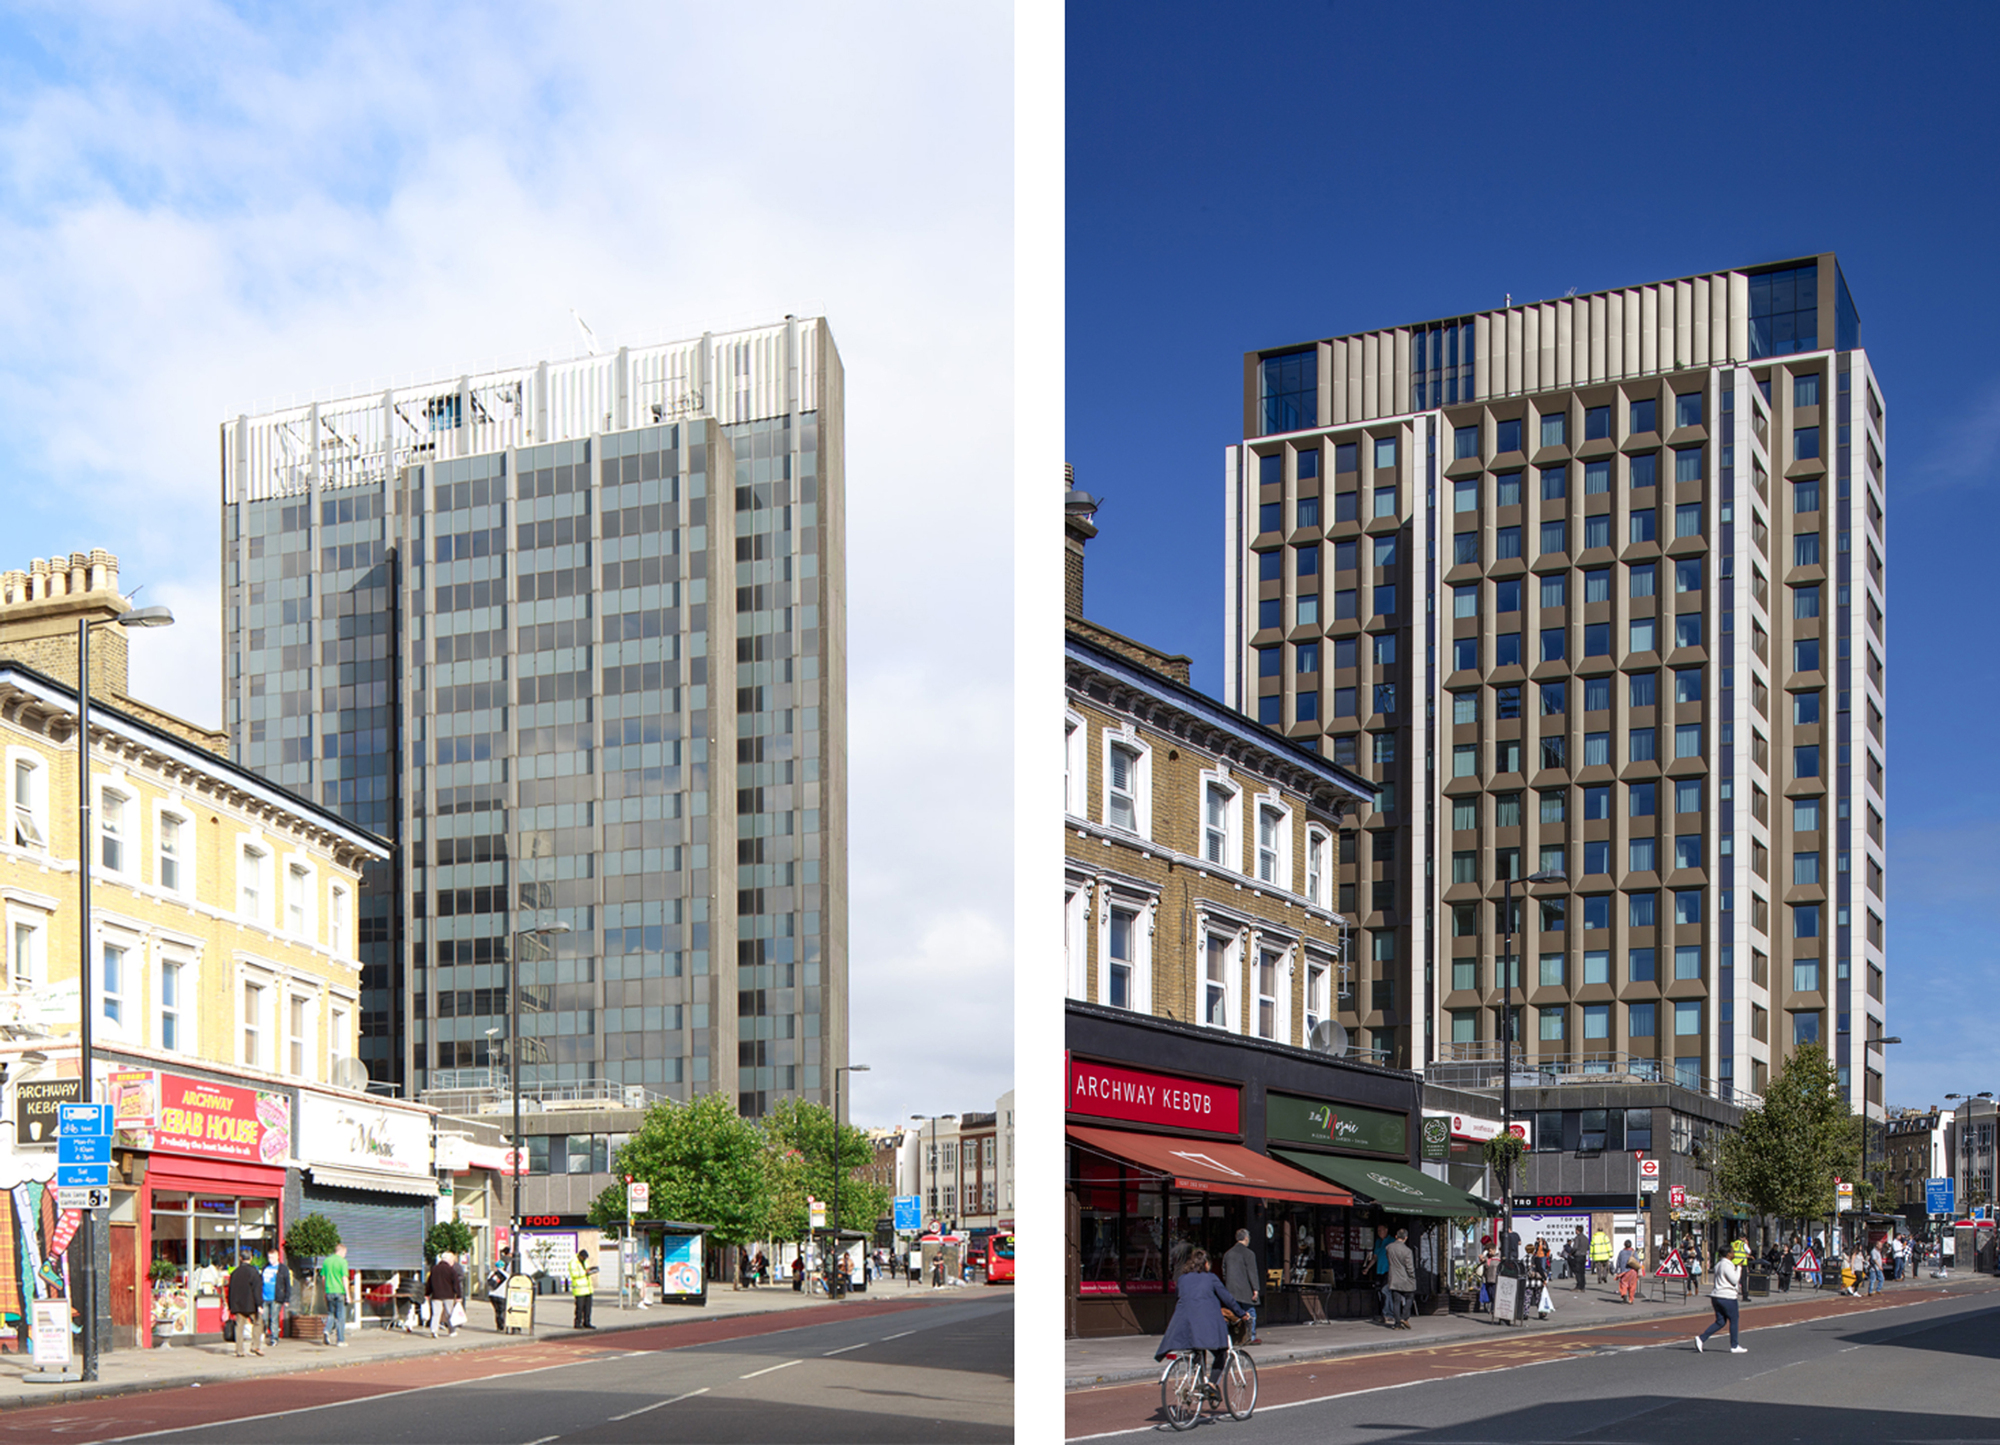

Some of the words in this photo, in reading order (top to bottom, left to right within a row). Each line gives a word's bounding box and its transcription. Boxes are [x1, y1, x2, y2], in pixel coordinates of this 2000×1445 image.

[17, 1083, 78, 1099] ARCHWAY
[1076, 1075, 1155, 1106] ARCHWAY
[26, 1100, 67, 1115] KEBA
[181, 1090, 234, 1112] ARCHWAY
[206, 1114, 259, 1145] HOUSE
[161, 1136, 190, 1150] Probably
[190, 1140, 202, 1149] the
[1536, 1196, 1573, 1207] FOOD
[1673, 1194, 1682, 1202] 24
[525, 1215, 561, 1226] FOOD
